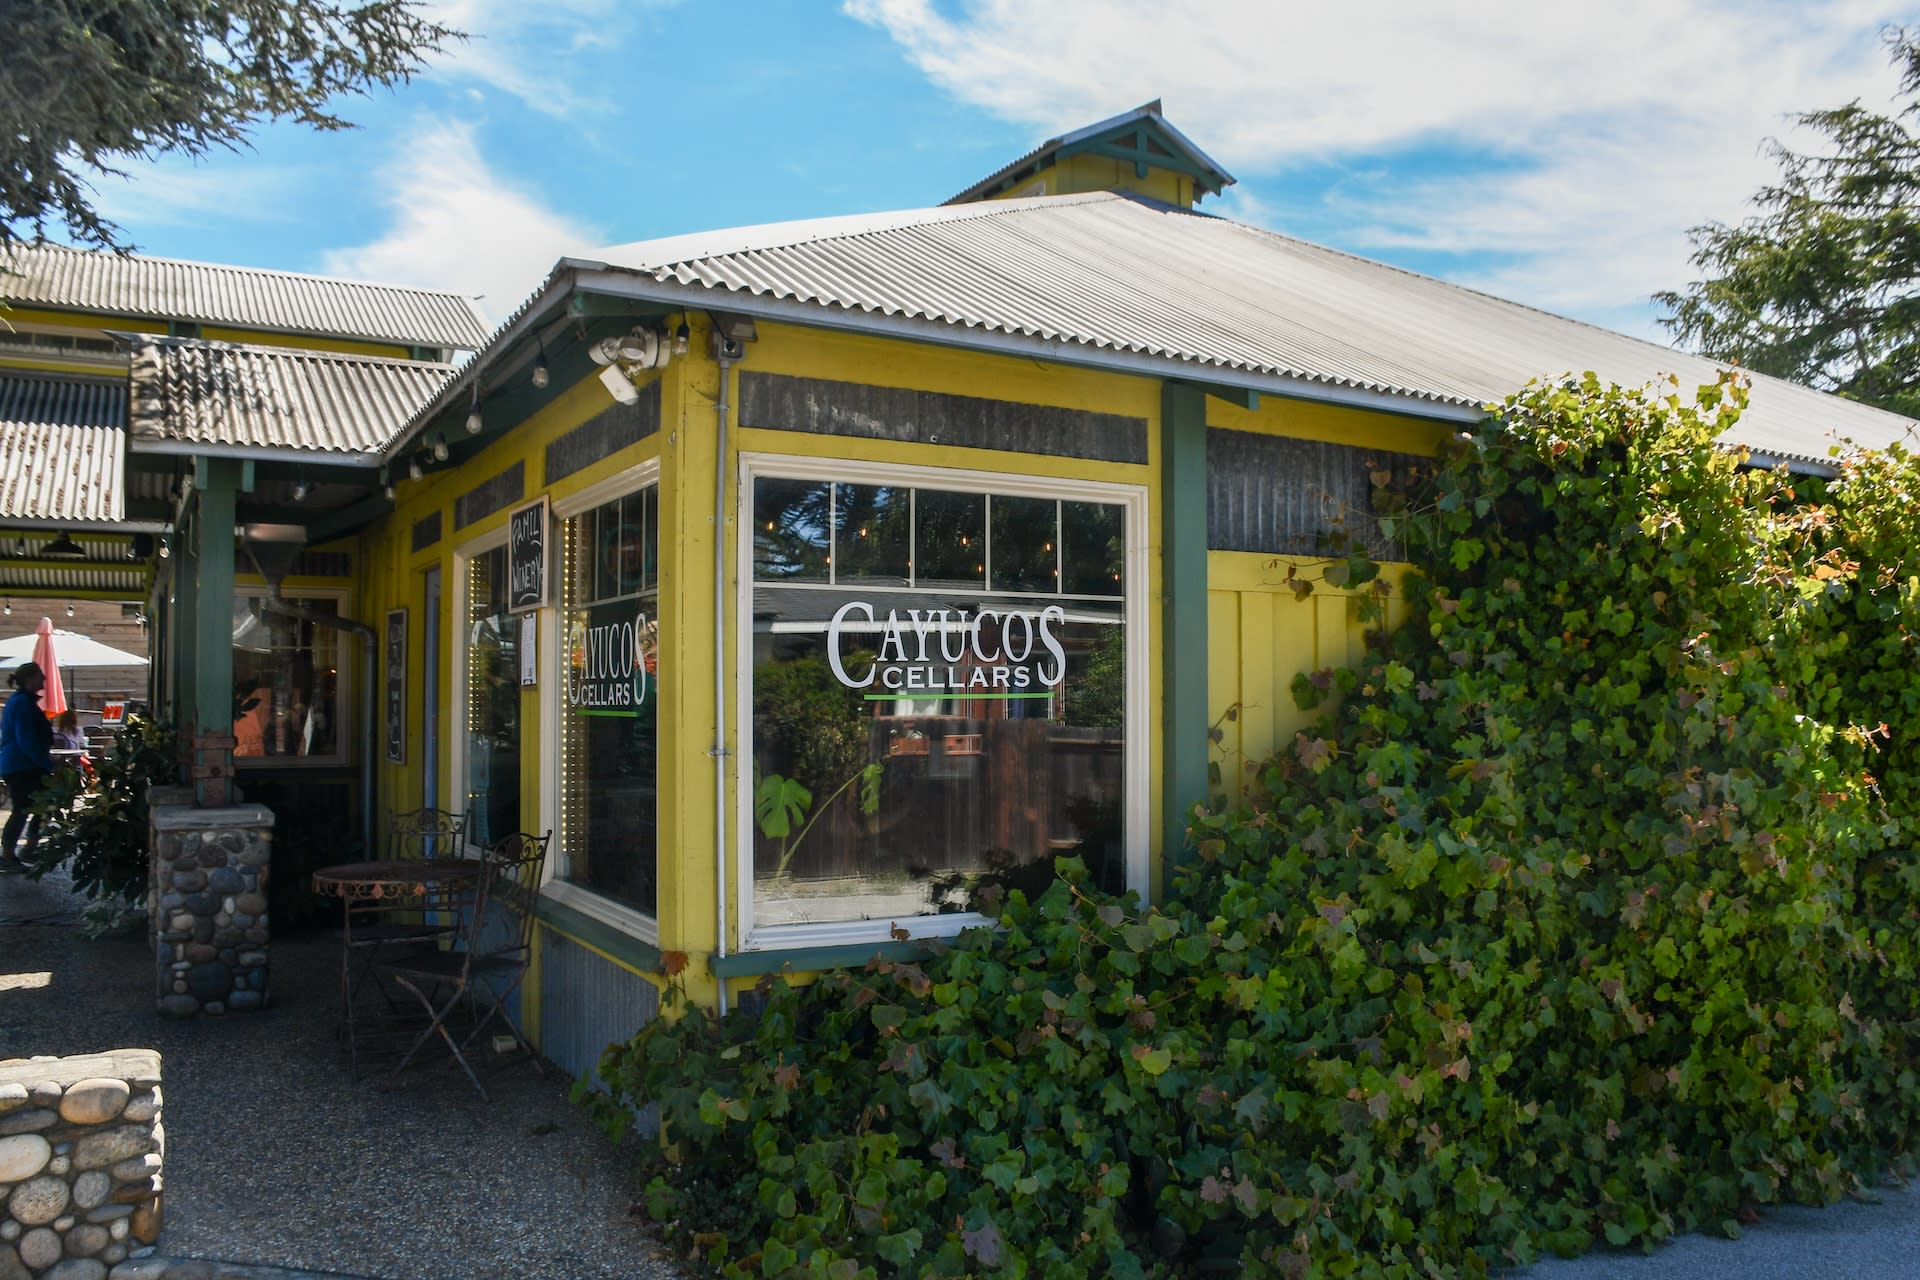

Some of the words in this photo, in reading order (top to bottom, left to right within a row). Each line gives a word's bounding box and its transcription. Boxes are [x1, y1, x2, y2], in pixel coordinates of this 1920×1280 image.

[512, 508, 543, 553] FAMILY
[512, 554, 543, 598] WINERY
[567, 613, 646, 705] CAYUCOS
[827, 601, 1066, 688] CAYUCOS
[580, 682, 631, 706] CELLARS
[882, 666, 1030, 688] CELLARS
